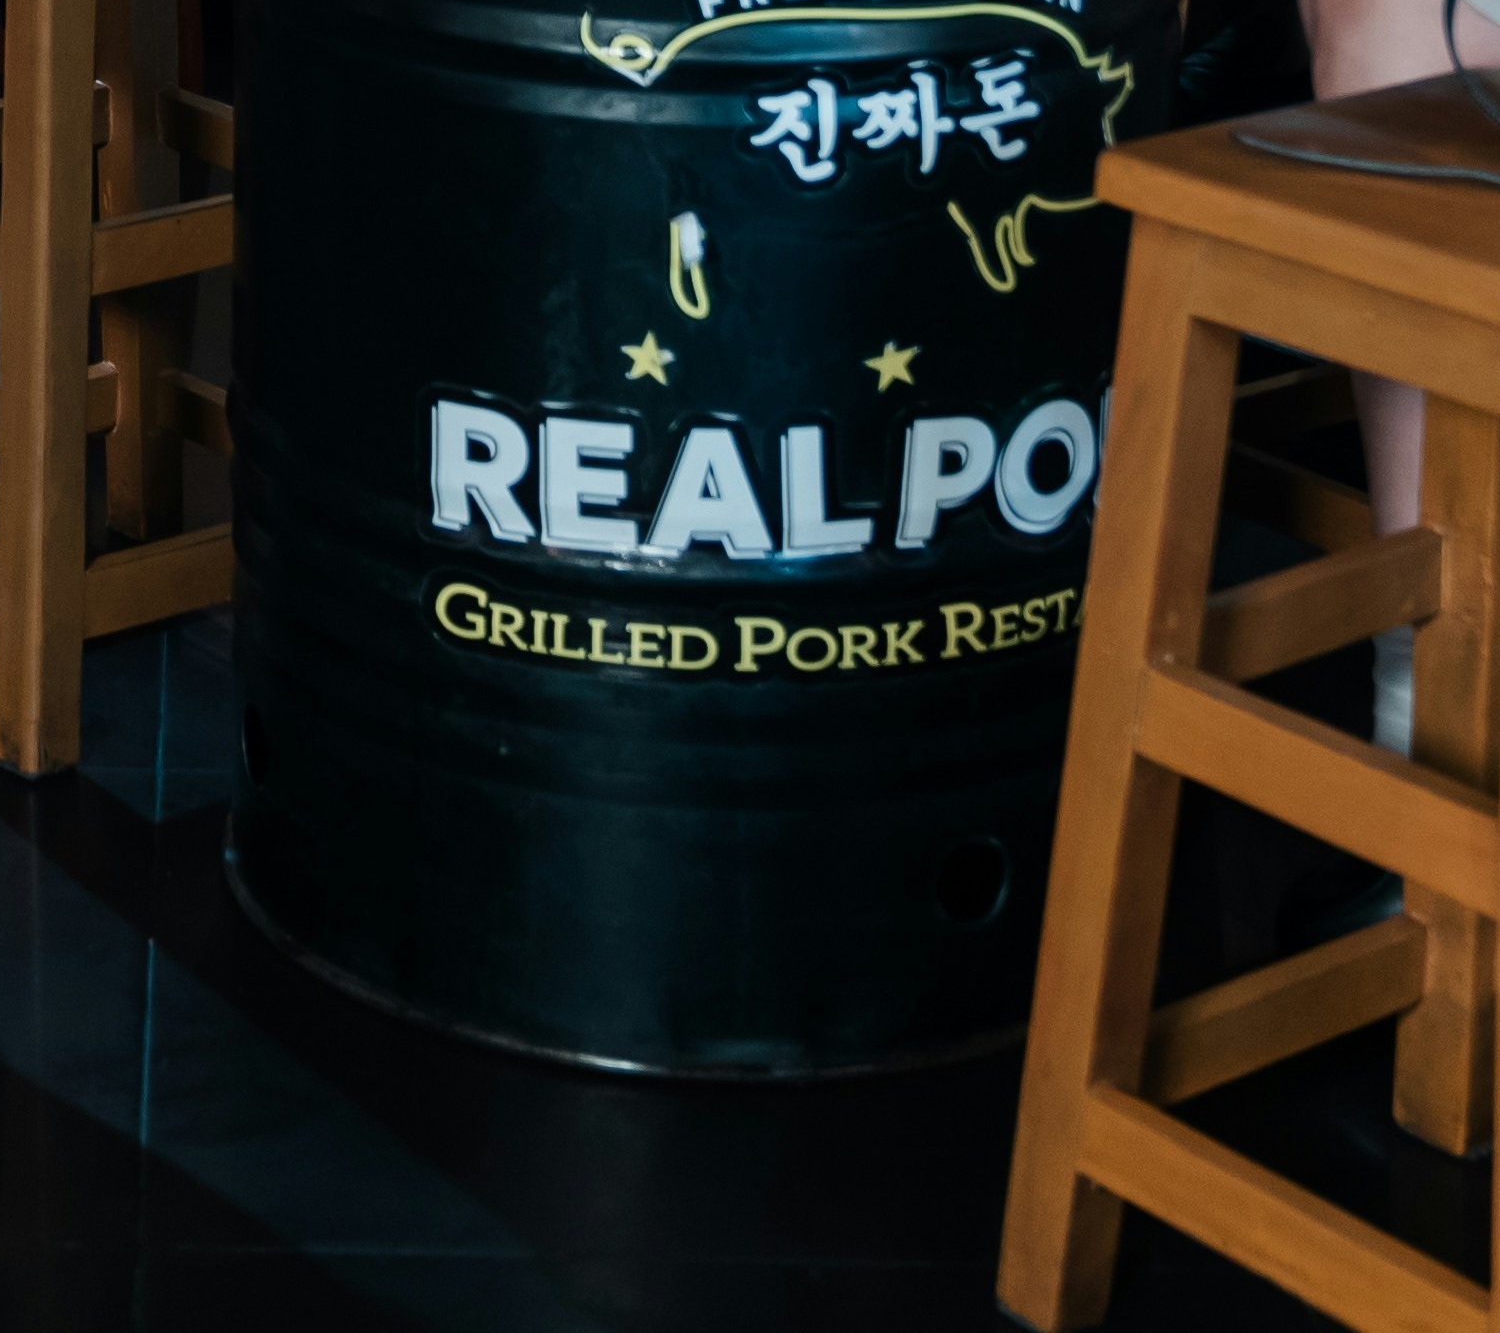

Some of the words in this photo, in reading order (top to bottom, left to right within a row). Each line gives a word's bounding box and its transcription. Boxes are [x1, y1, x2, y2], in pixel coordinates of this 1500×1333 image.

[749, 58, 1041, 183] 진짜돈
[431, 399, 875, 561] REAL
[895, 387, 1114, 549] PO
[940, 587, 1085, 660] REST
